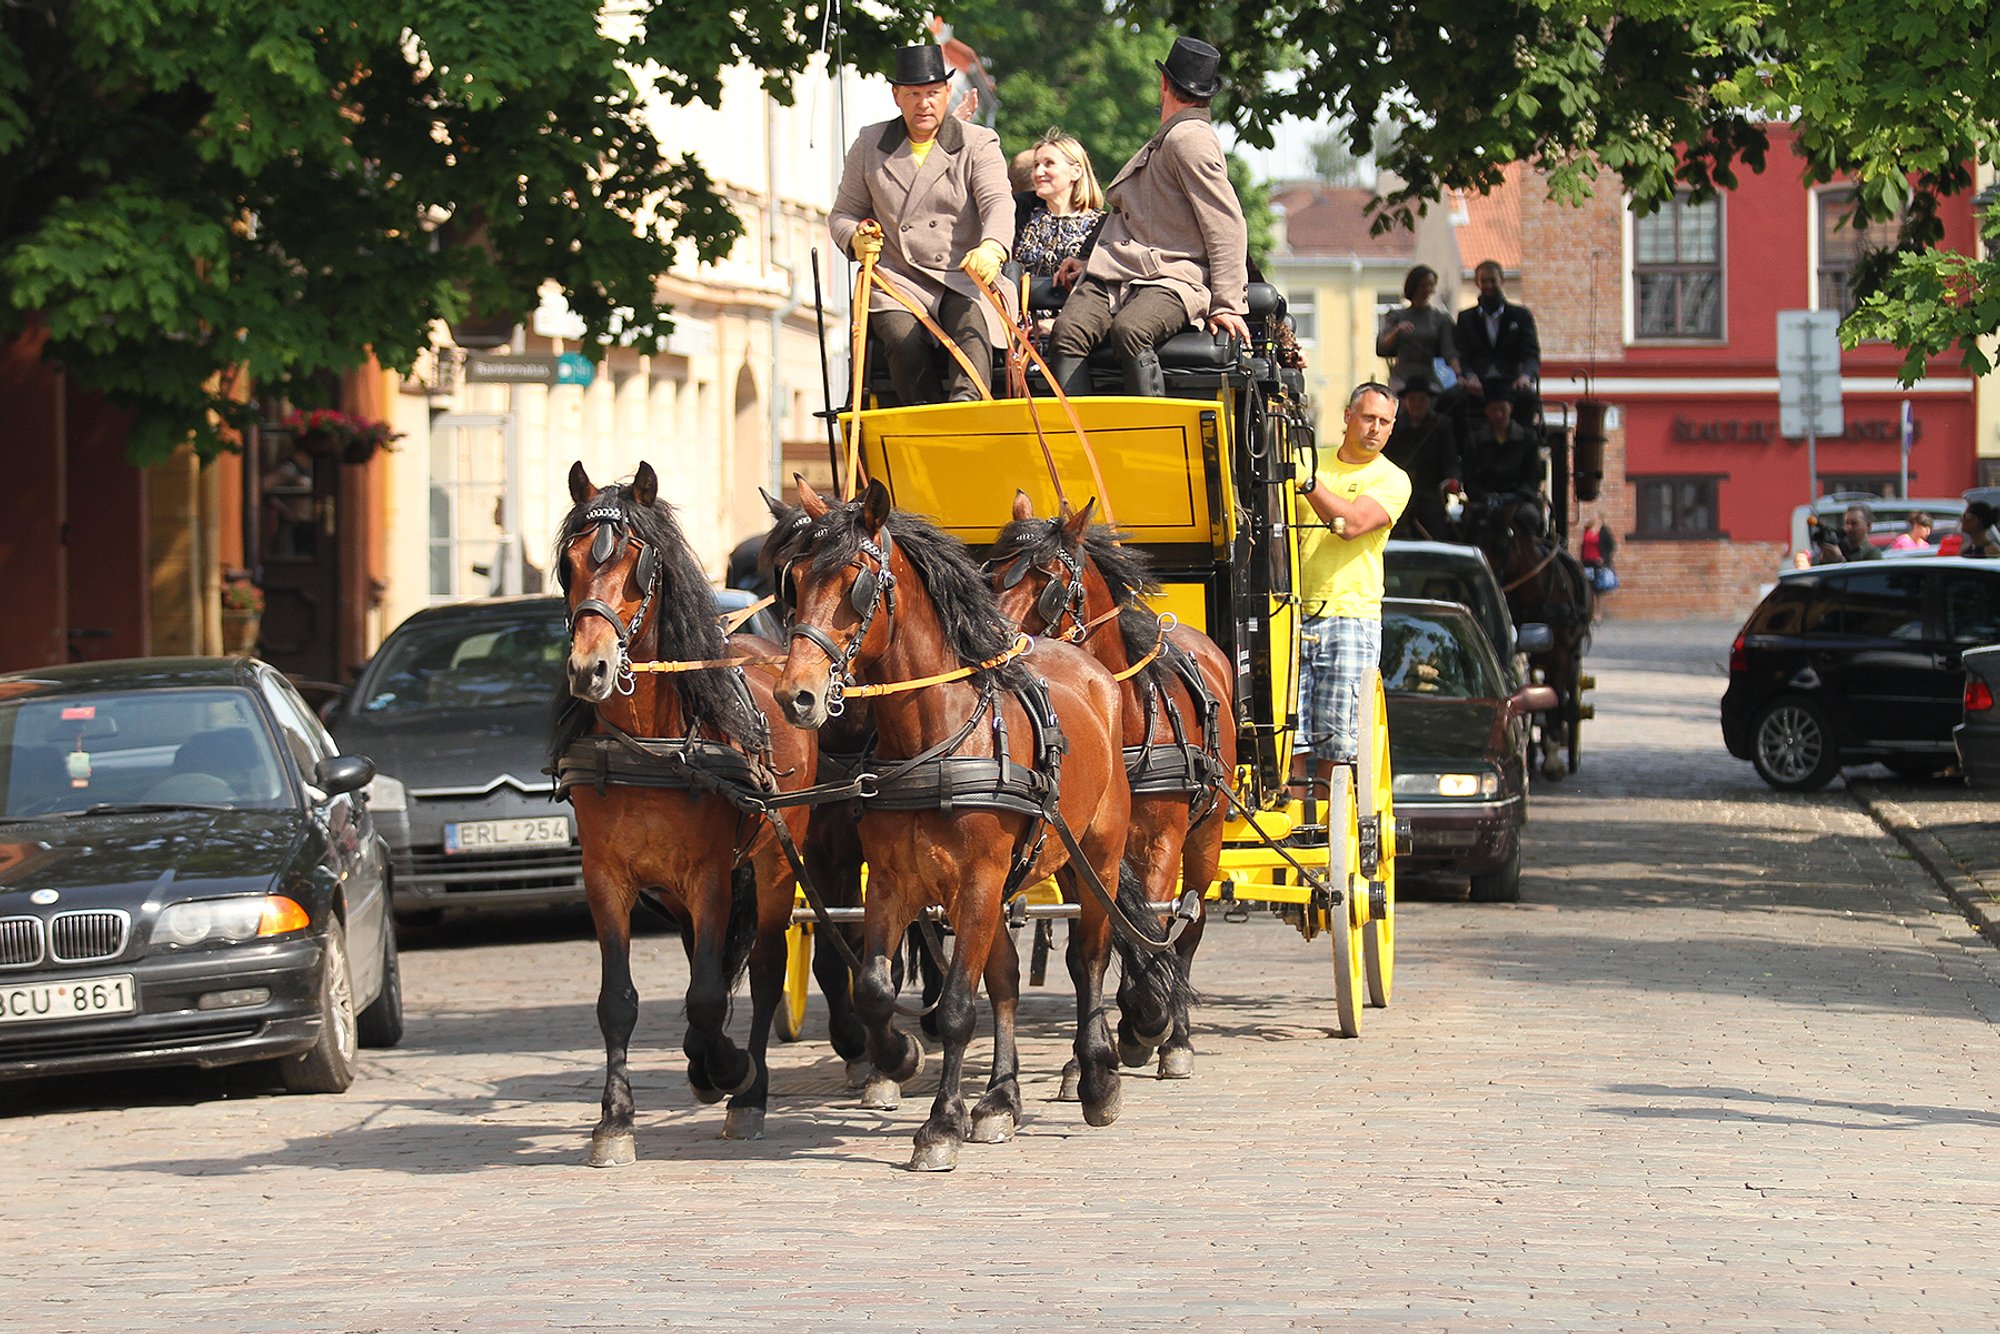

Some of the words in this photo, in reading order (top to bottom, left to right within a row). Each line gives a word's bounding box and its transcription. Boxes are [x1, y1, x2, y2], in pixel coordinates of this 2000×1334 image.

[460, 822, 509, 845] ERL
[524, 820, 564, 841] 254
[73, 982, 125, 1011] 861
